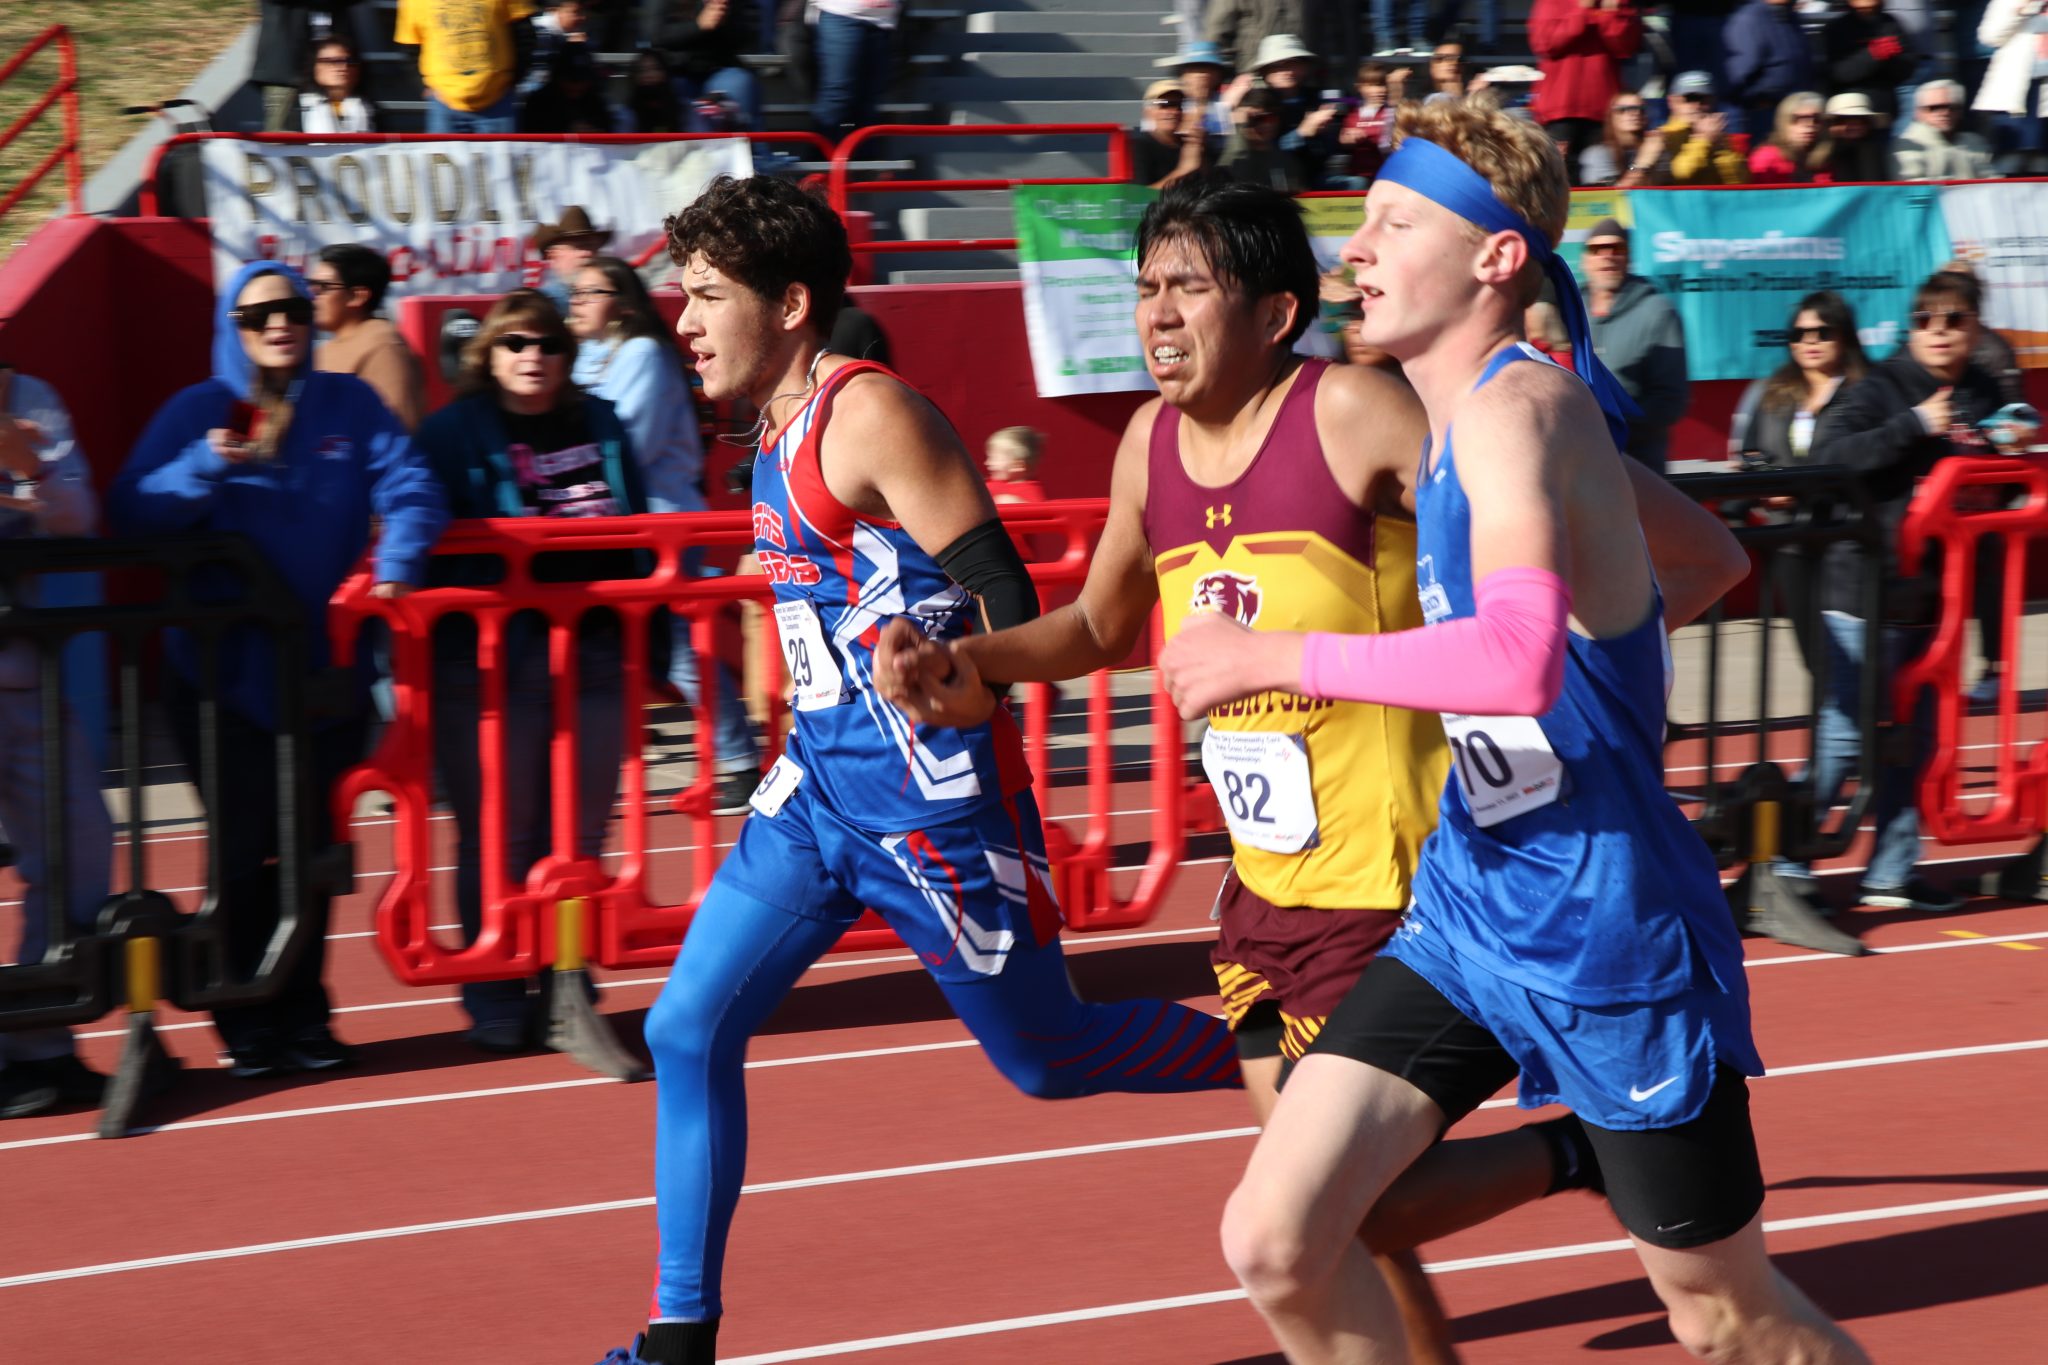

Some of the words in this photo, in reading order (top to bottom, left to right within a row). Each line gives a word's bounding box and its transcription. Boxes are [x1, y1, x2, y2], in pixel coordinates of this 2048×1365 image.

[245, 152, 537, 226] PROUDLY
[788, 637, 813, 687] 29
[1223, 769, 1276, 824] 82
